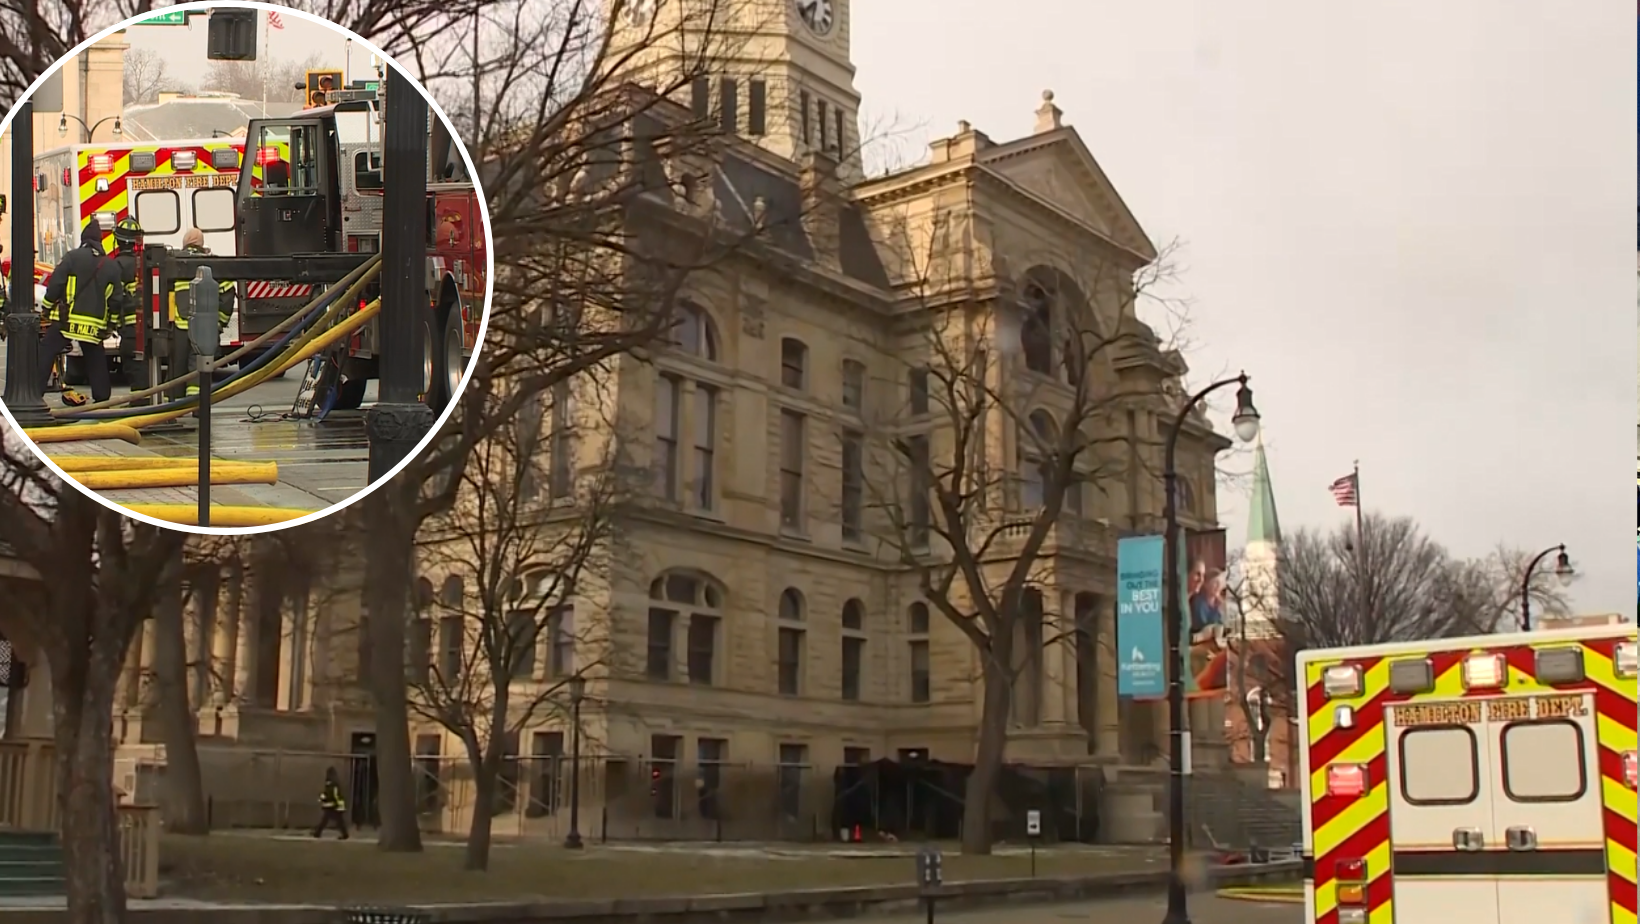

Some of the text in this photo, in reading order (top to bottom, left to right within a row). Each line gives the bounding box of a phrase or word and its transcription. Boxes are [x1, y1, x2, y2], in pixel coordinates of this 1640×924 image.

[132, 177, 182, 190] HAMILTON
[185, 175, 209, 188] FIRE
[1132, 588, 1159, 602] BEST
[1120, 600, 1159, 614] IN YOU
[1394, 695, 1589, 726] HAMILTON FIRE DEPT.
